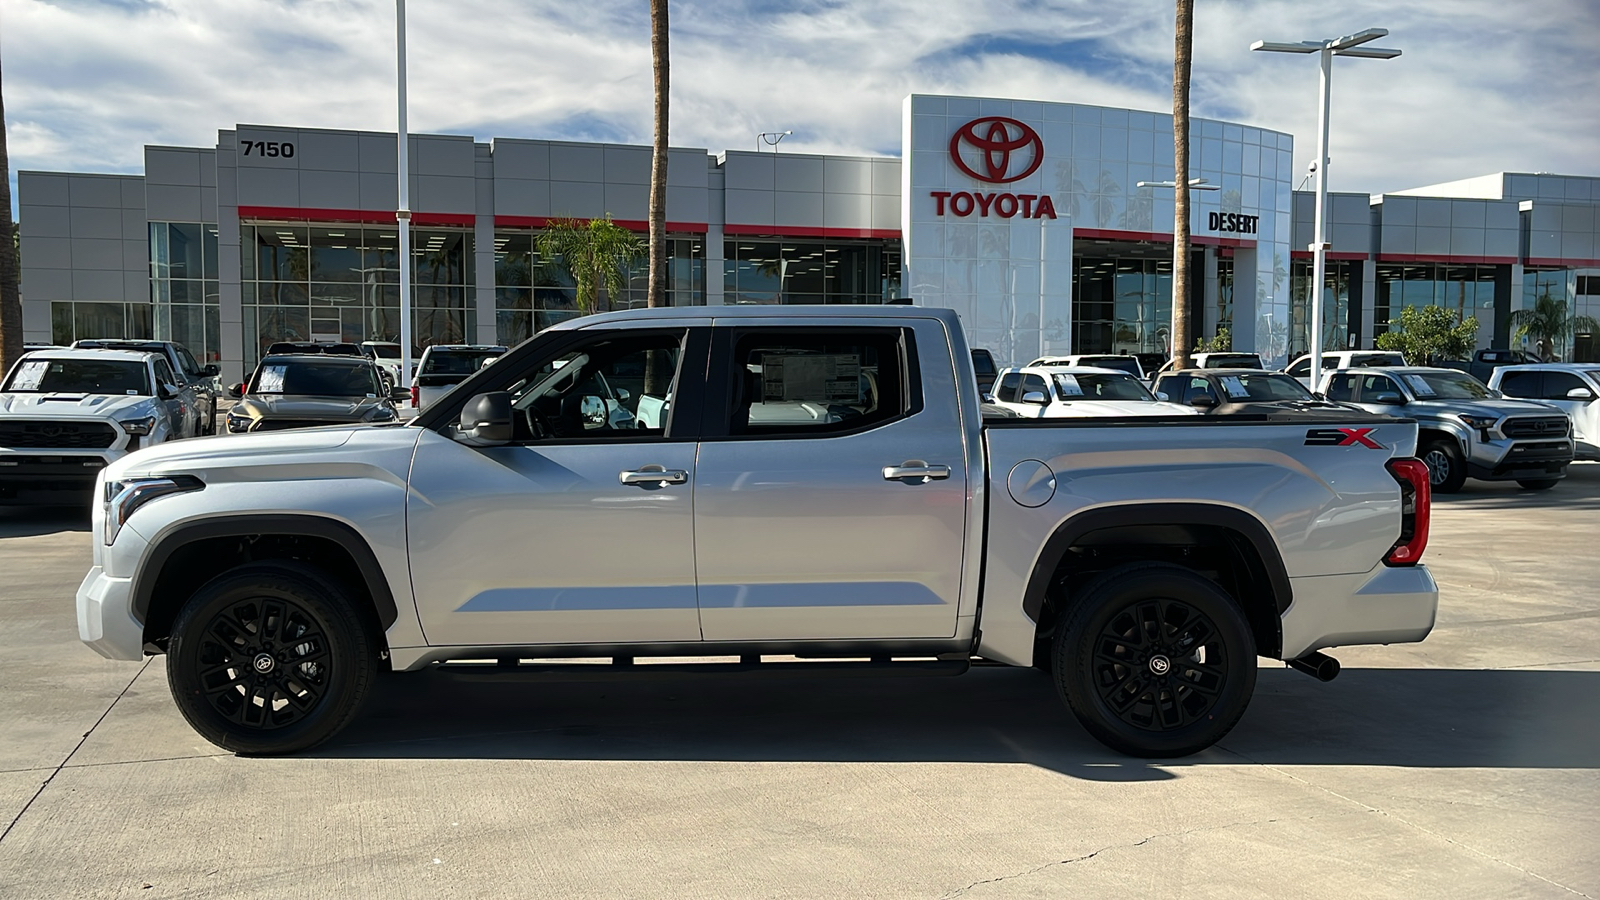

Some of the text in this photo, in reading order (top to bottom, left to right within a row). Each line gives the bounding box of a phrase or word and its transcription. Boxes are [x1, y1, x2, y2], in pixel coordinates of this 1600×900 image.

[241, 140, 294, 158] 7150
[930, 191, 1057, 220] TOYOTA
[1209, 211, 1259, 235] DESERT
[1303, 427, 1388, 450] SX
